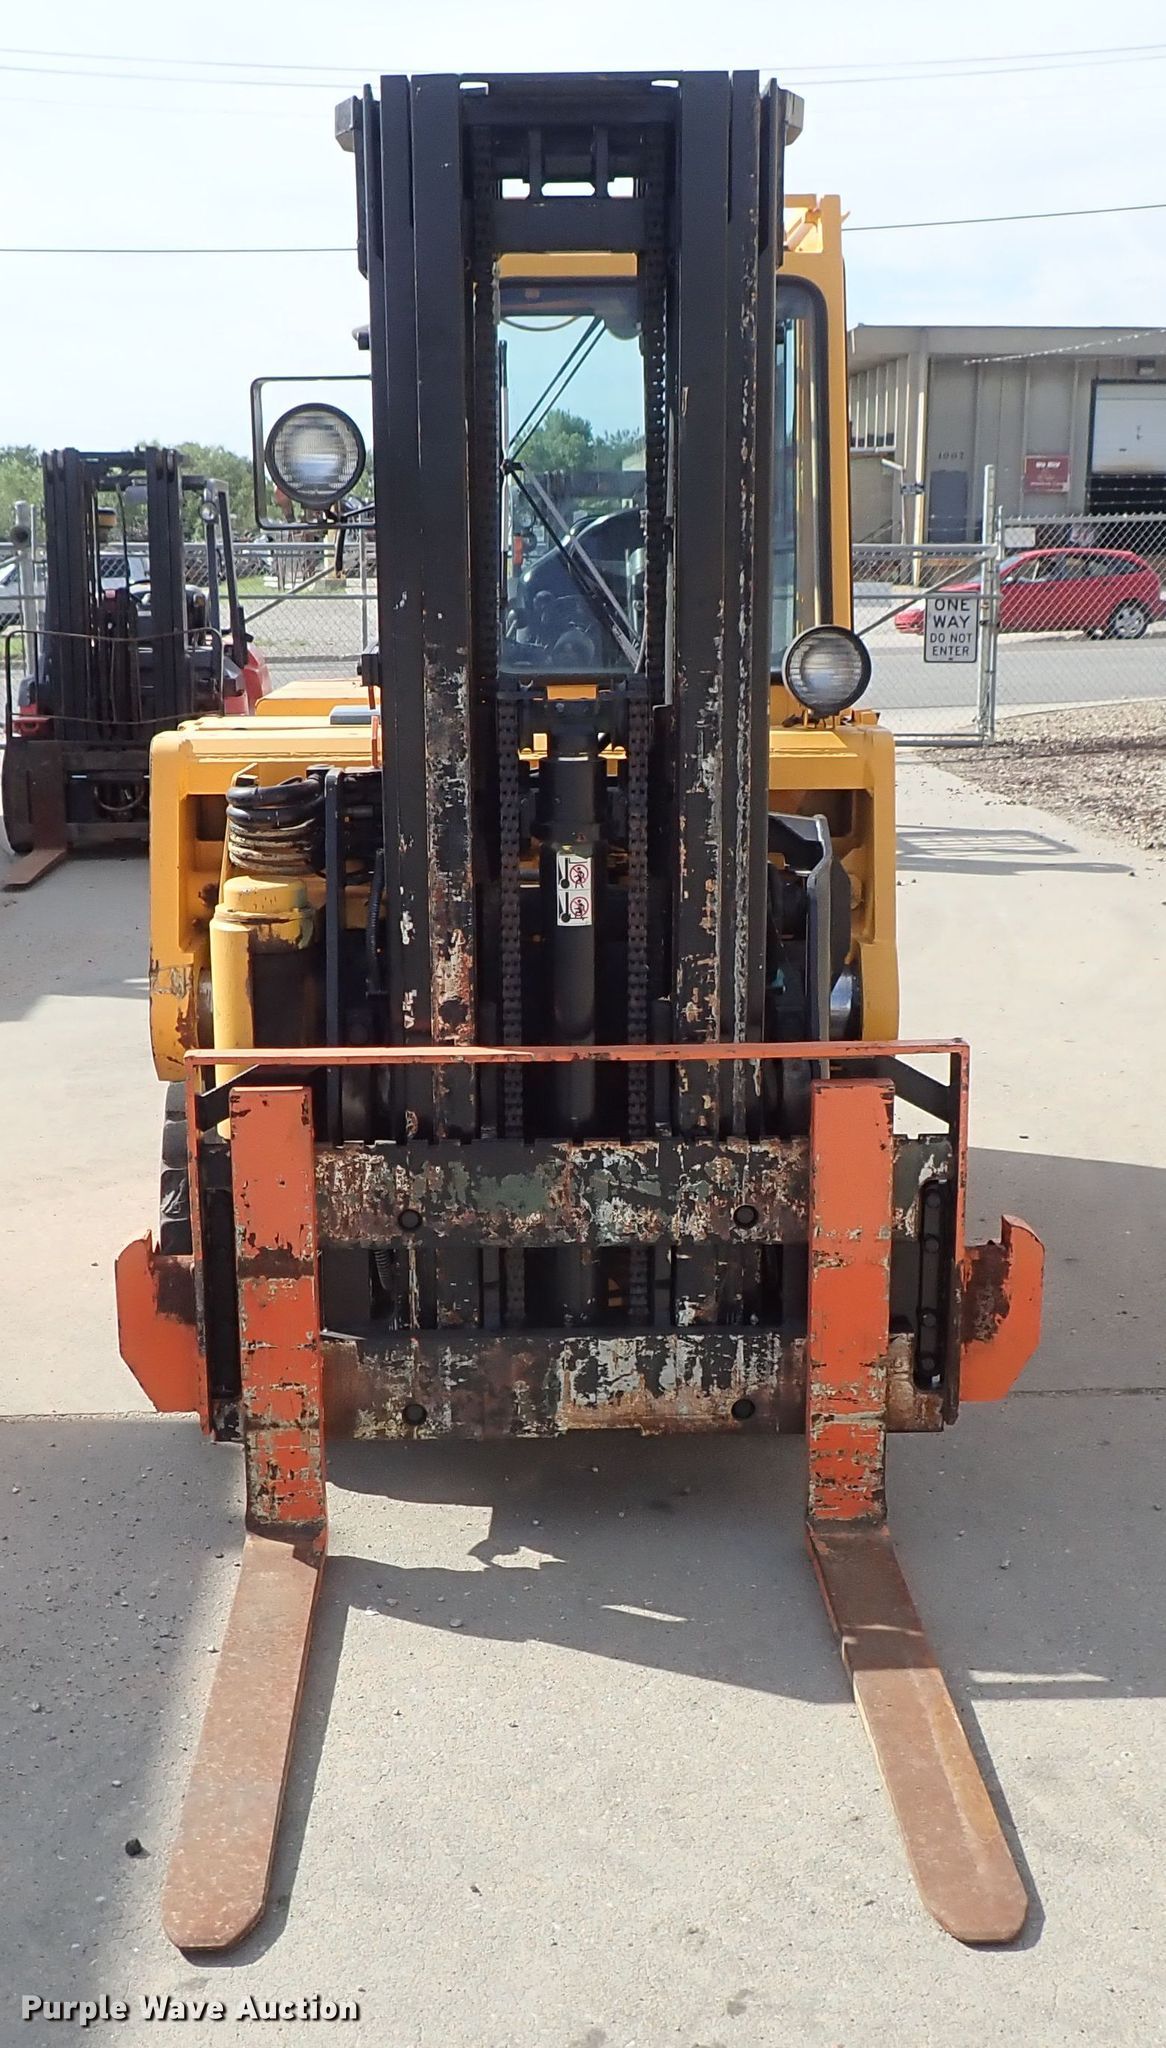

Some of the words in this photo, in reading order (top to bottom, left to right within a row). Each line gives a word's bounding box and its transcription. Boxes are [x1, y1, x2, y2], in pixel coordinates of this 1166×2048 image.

[934, 598, 971, 612] ONE
[933, 615, 971, 629] WAY
[930, 632, 946, 643] DO
[950, 632, 973, 643] NOT
[932, 645, 970, 657] ENTER
